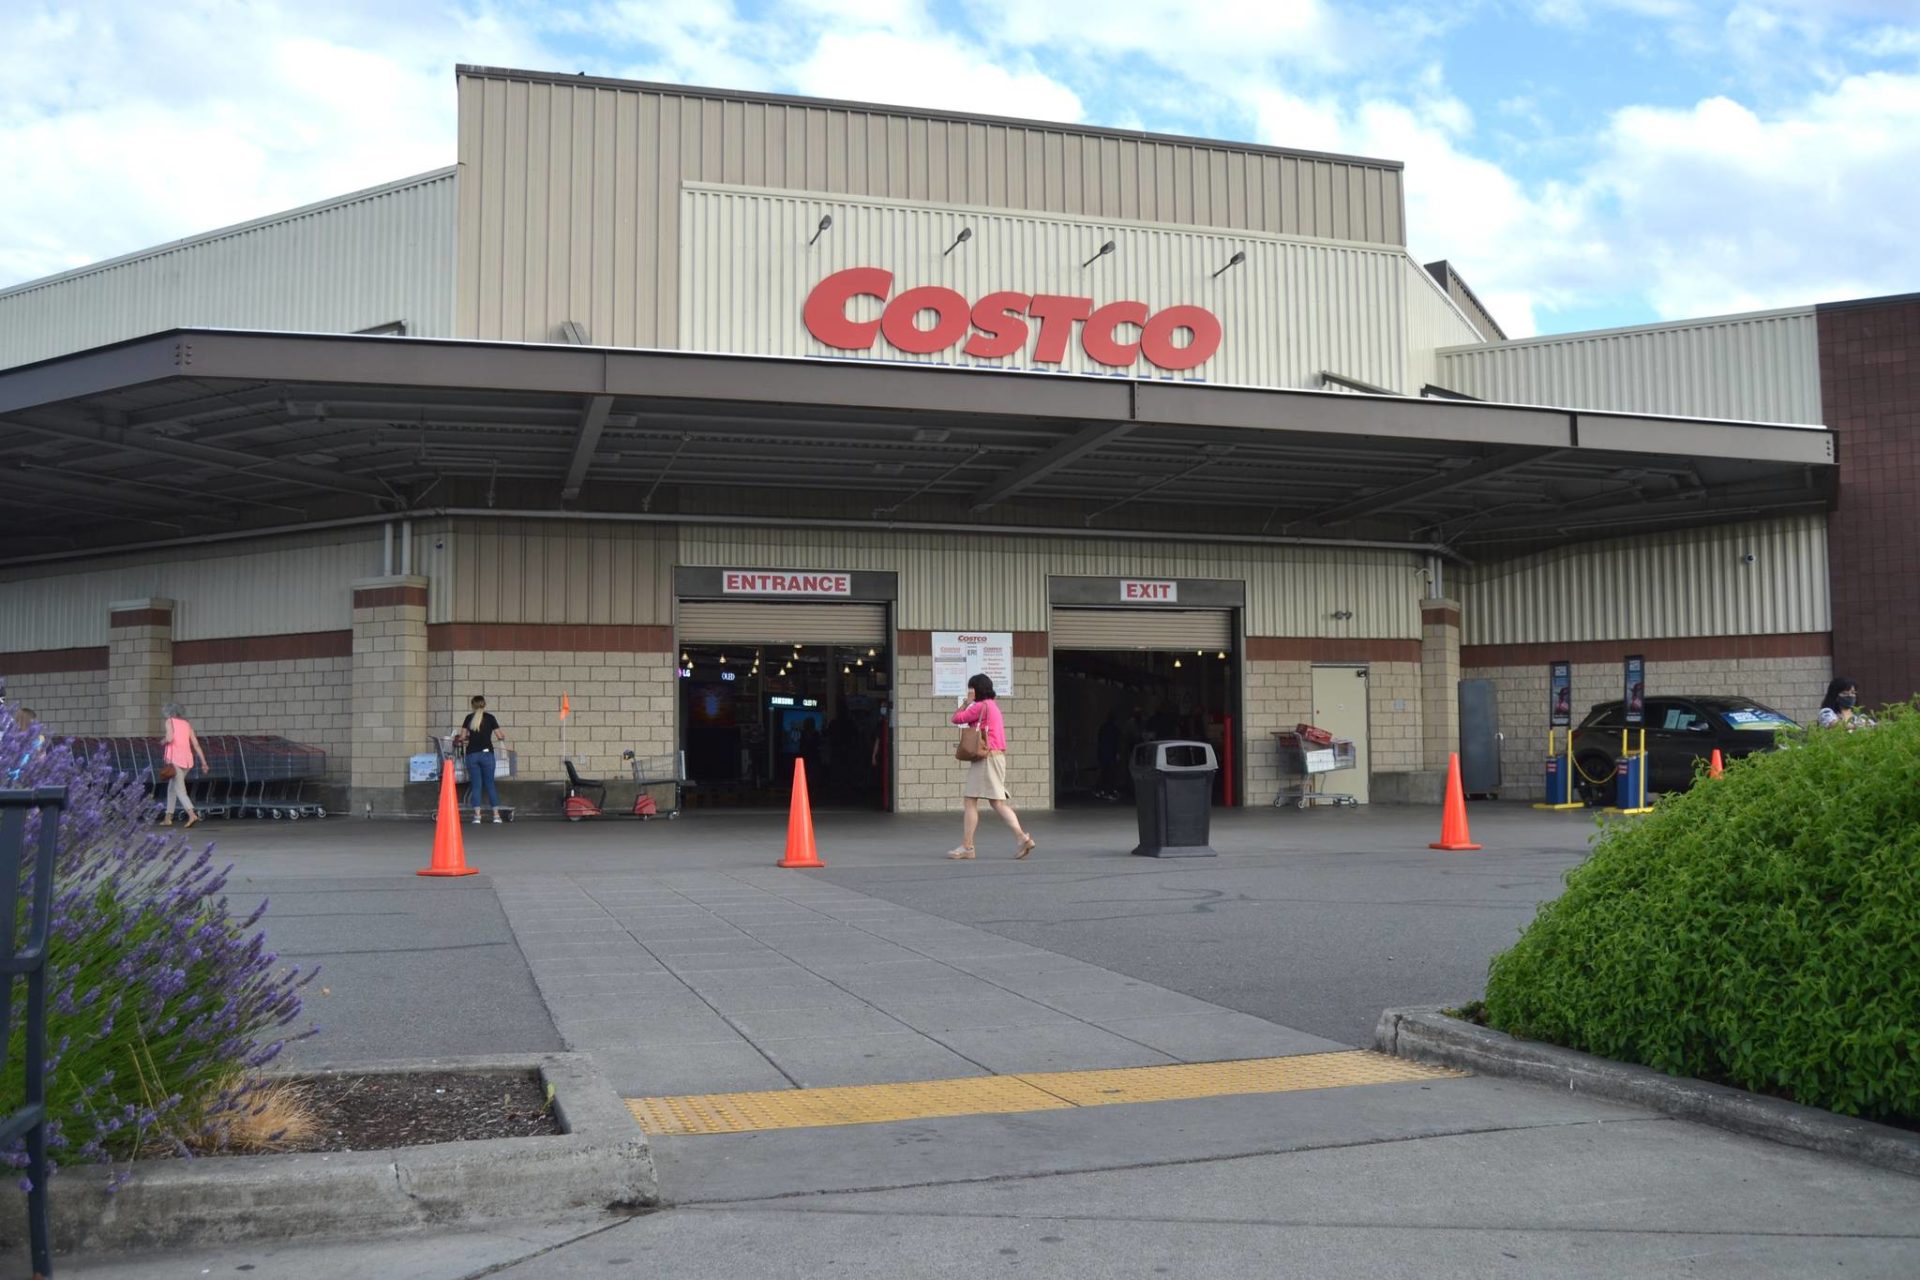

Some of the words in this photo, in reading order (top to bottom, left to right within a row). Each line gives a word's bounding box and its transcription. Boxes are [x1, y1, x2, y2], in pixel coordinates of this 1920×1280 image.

[804, 267, 1222, 370] COSTCO
[727, 575, 847, 592] ENTRANCE
[1126, 583, 1171, 598] EXIT
[682, 669, 691, 677] LG
